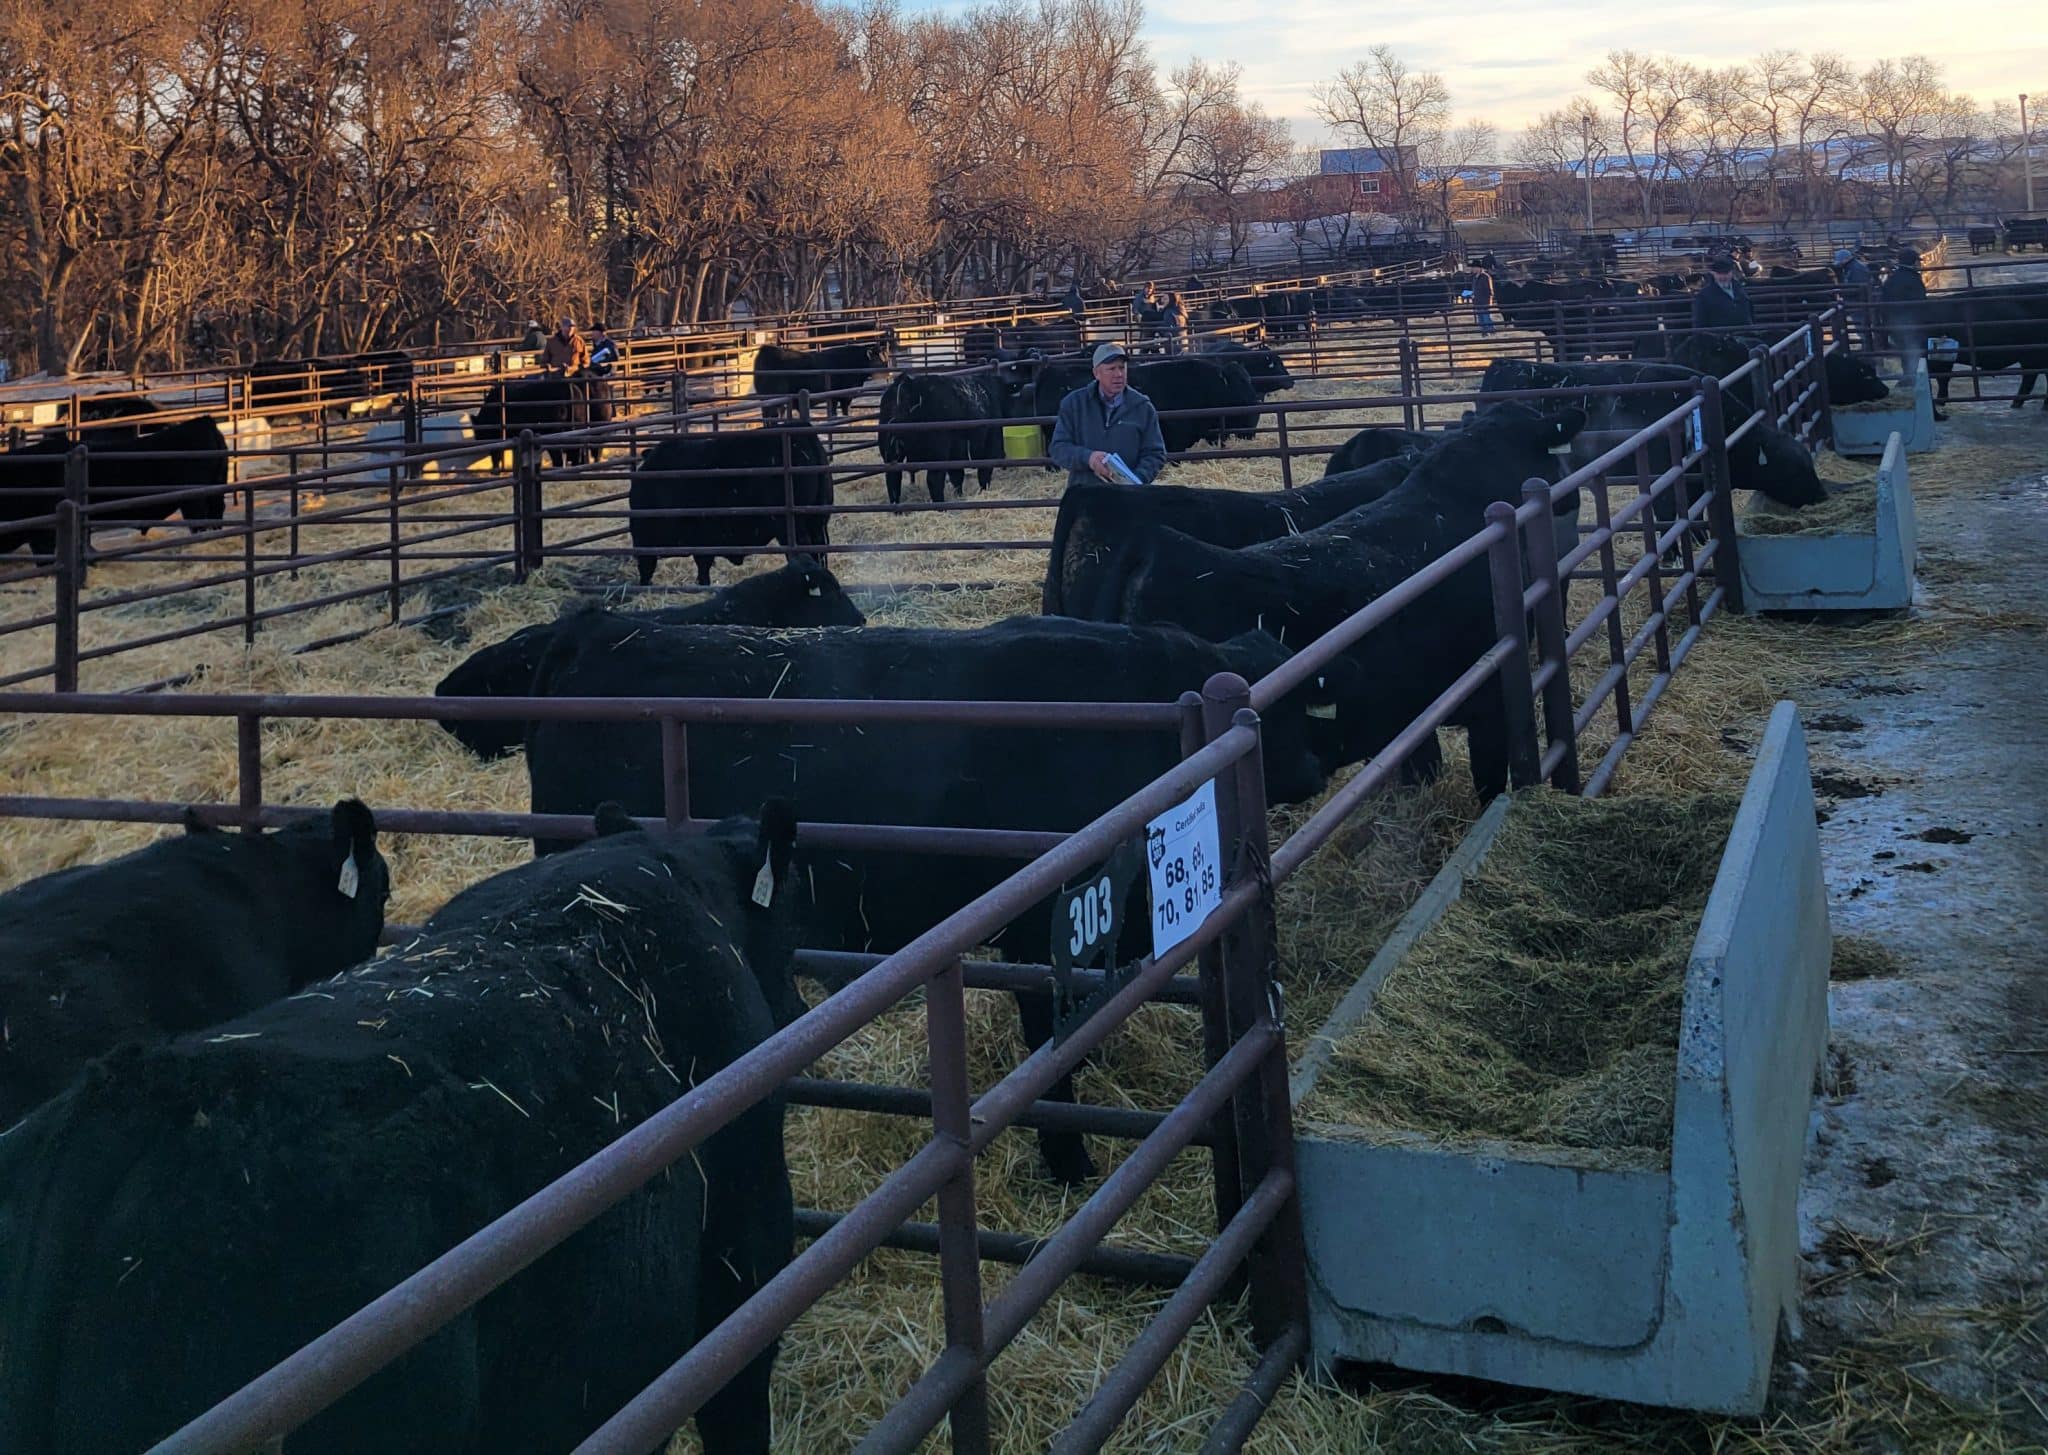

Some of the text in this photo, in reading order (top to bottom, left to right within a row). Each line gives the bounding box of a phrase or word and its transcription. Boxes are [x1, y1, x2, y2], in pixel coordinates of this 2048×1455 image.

[1158, 898, 1180, 931] 70,
[1201, 864, 1215, 895] 85
[1165, 857, 1190, 888] 68,
[1069, 876, 1113, 957] 303
